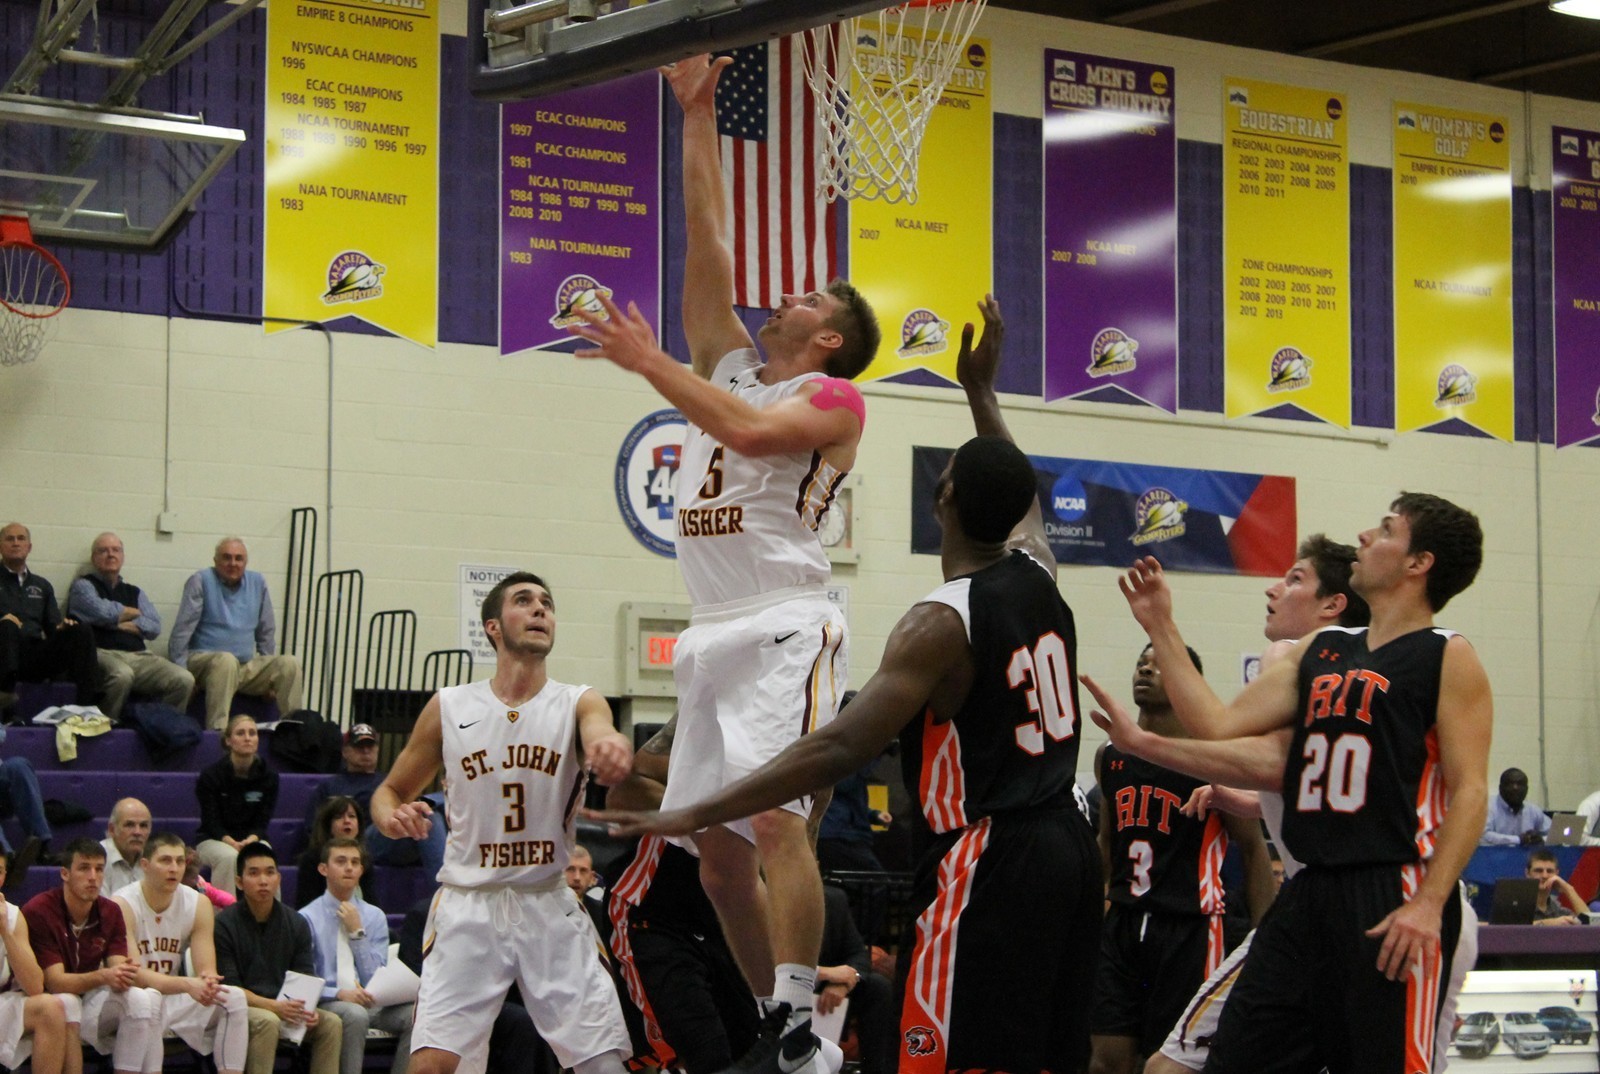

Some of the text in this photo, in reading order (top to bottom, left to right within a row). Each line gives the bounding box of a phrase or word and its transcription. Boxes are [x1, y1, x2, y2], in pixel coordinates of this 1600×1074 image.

[297, 5, 414, 32] EMPIRE 8 CHAMPIONS
[282, 57, 306, 70] 1996
[292, 41, 418, 68] NYSWCAA CHAMPIONS
[1085, 63, 1136, 90] MEN'S
[306, 79, 403, 101] ECAC CHAMPIONS
[1049, 80, 1172, 117] CROSS COUNTRY
[281, 92, 367, 113] 1984 1985 1987
[298, 113, 410, 137] NCAA TOURNAMENT
[509, 124, 533, 137] 1997
[536, 110, 627, 133] ECAC CHAMPIONS
[1239, 108, 1335, 140] EQUESTRIAN
[1419, 113, 1486, 141] WOMEN'S
[344, 135, 367, 148] 1990
[374, 139, 397, 152] 1996
[404, 143, 427, 156] 1997
[535, 142, 627, 164] PCAC CHAMPIONS
[1232, 138, 1342, 162] REGIONAL CHAMPIONSHIPS
[1434, 137, 1470, 158] GOLF
[509, 155, 532, 168] 1981
[1411, 162, 1439, 176] EMPIRE
[299, 184, 408, 205] NAIA TOURNAMENT
[528, 175, 634, 198] NCAA TOURNAMENT
[1239, 183, 1285, 198] 2010 2011
[280, 198, 304, 211] 1983
[509, 189, 647, 215] 1984 1986 1987 1990 1998
[509, 205, 562, 222] 2008 2010
[859, 228, 880, 240] 2007
[895, 218, 948, 234] NCAA MEET
[509, 252, 532, 265] 1983
[530, 237, 631, 259] NAIA TOURNAMENT
[1242, 258, 1334, 279] ZONE CHAMPIONSHIPS
[1413, 279, 1492, 296] NCAA TOURNAMENT
[1291, 296, 1312, 308] 2010
[1316, 299, 1336, 311] 2011
[1573, 299, 1595, 311] NCAA
[698, 444, 724, 500] 5
[1053, 496, 1087, 511] NCAA
[1045, 522, 1084, 537] Division
[1006, 631, 1077, 757] 30
[1304, 668, 1391, 728] RIT
[461, 743, 562, 781] ST. JOHN
[1296, 732, 1373, 814] 20
[502, 782, 526, 834] 3
[1115, 784, 1182, 836] RIT
[479, 839, 556, 869] FISHER
[1127, 840, 1154, 898] 3
[154, 936, 183, 955] JOH
